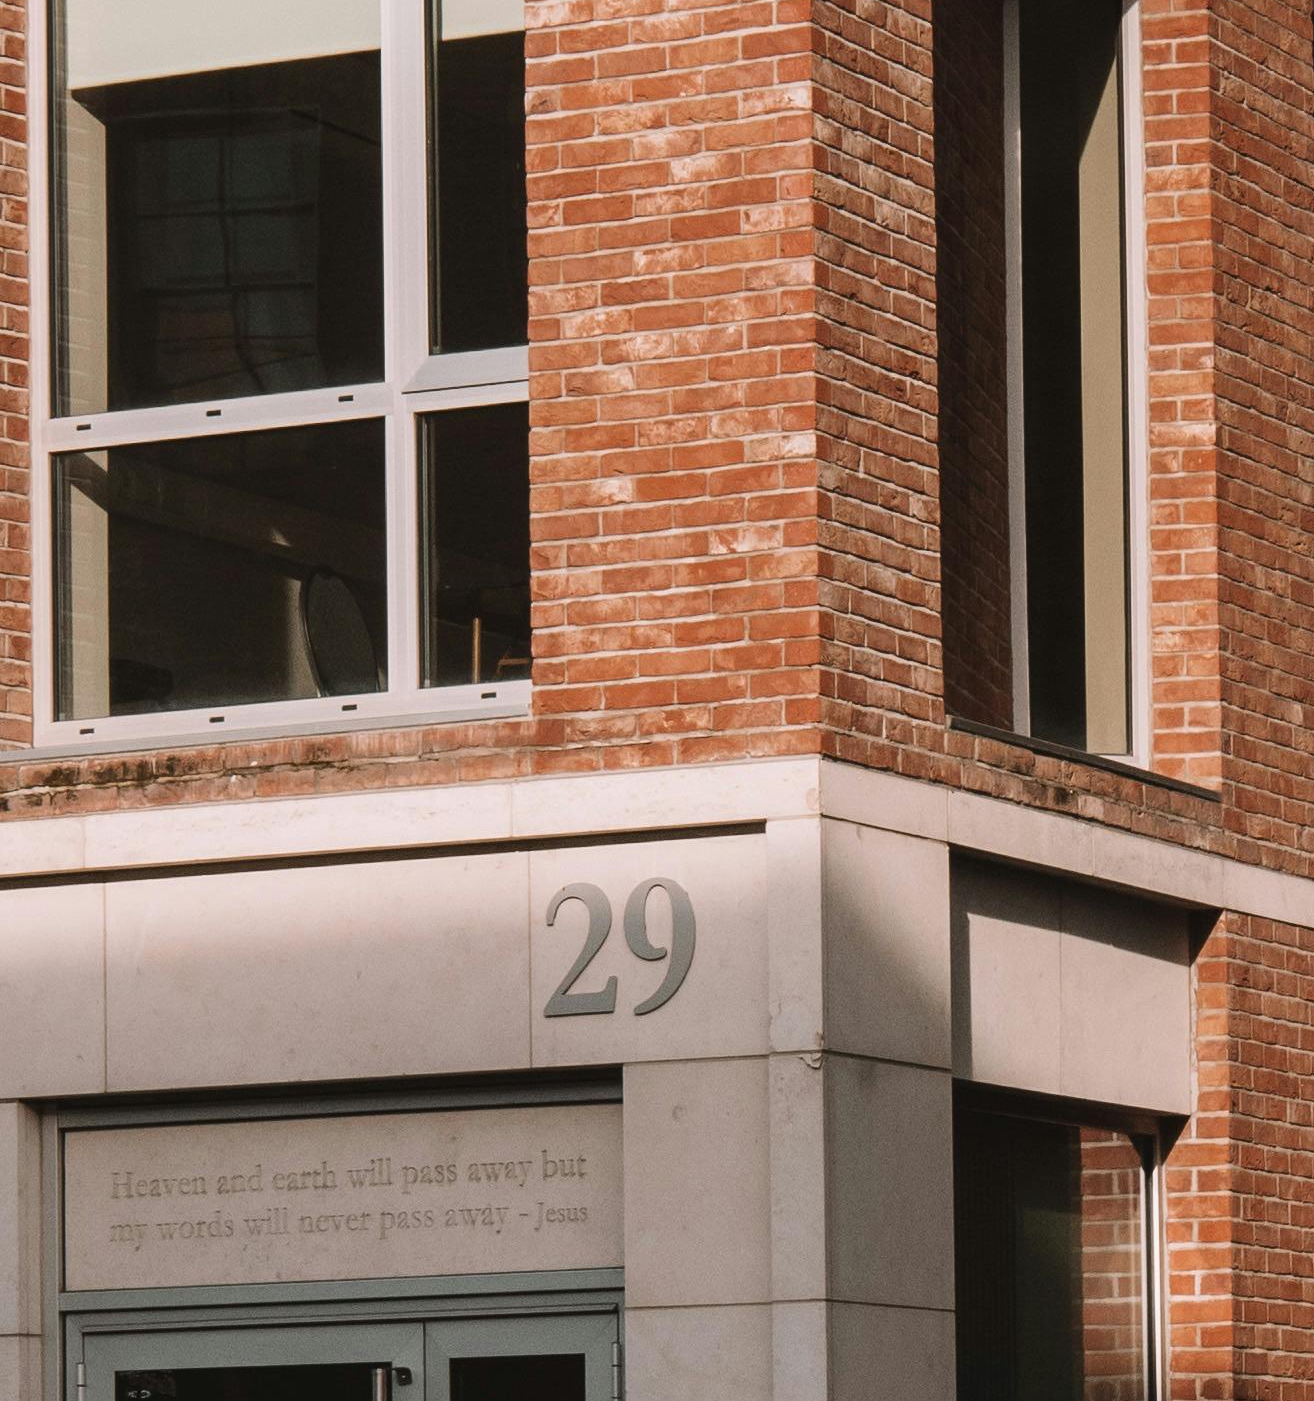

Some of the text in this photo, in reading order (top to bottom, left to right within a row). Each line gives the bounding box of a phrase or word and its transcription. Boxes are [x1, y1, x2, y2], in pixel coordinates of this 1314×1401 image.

[543, 877, 697, 1018] 29
[110, 1149, 588, 1200] Heaven and earth will pass away but
[110, 1222, 148, 1252] my
[156, 1210, 234, 1240] words
[243, 1207, 290, 1237] will
[298, 1210, 370, 1234] never
[379, 1210, 435, 1240] pass
[445, 1205, 510, 1235] away
[534, 1201, 588, 1232] Jesus
